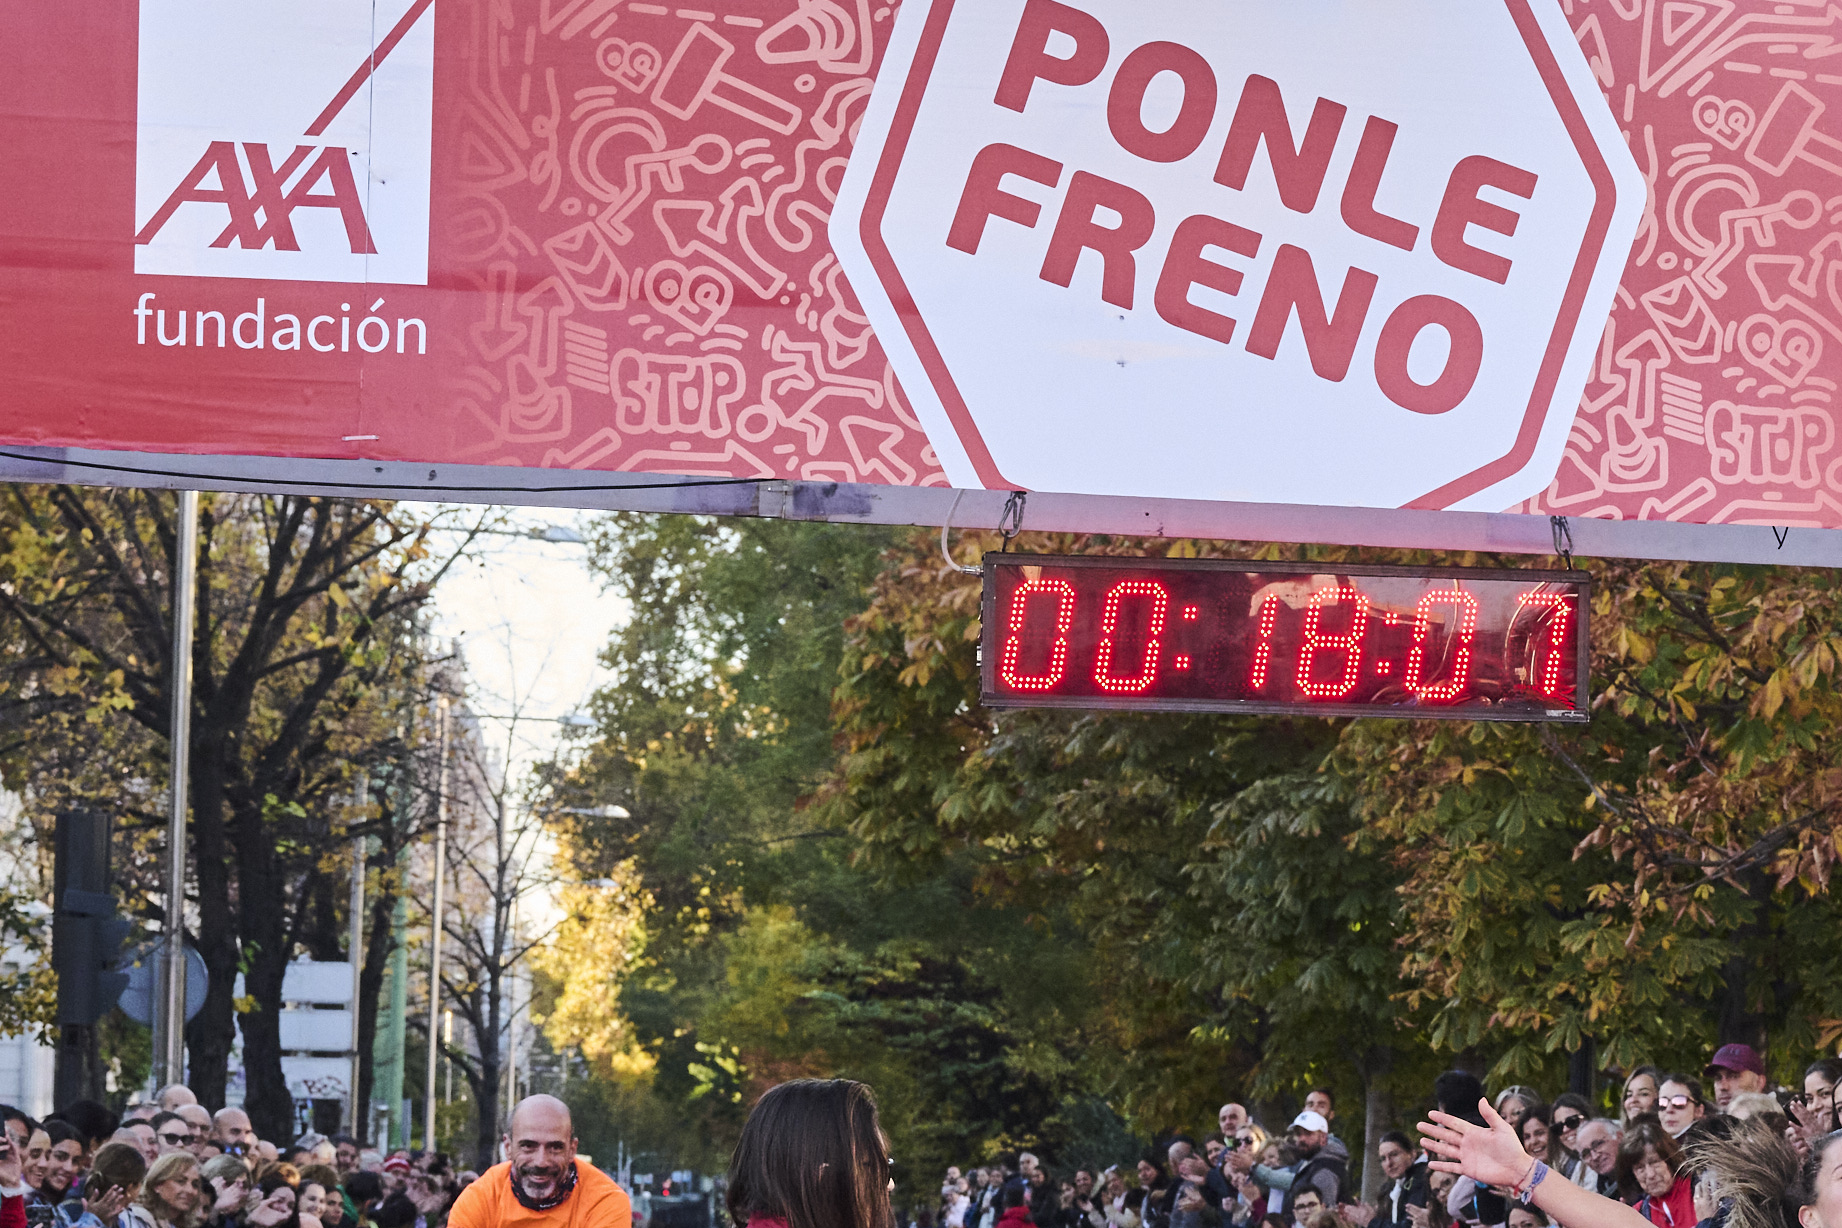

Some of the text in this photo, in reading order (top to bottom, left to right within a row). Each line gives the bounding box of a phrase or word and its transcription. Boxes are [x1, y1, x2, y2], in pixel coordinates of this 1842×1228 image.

[134, 140, 379, 255] AXA
[992, 0, 1540, 286] PONLE
[133, 292, 428, 355] fundación
[945, 142, 1485, 416] FRENO
